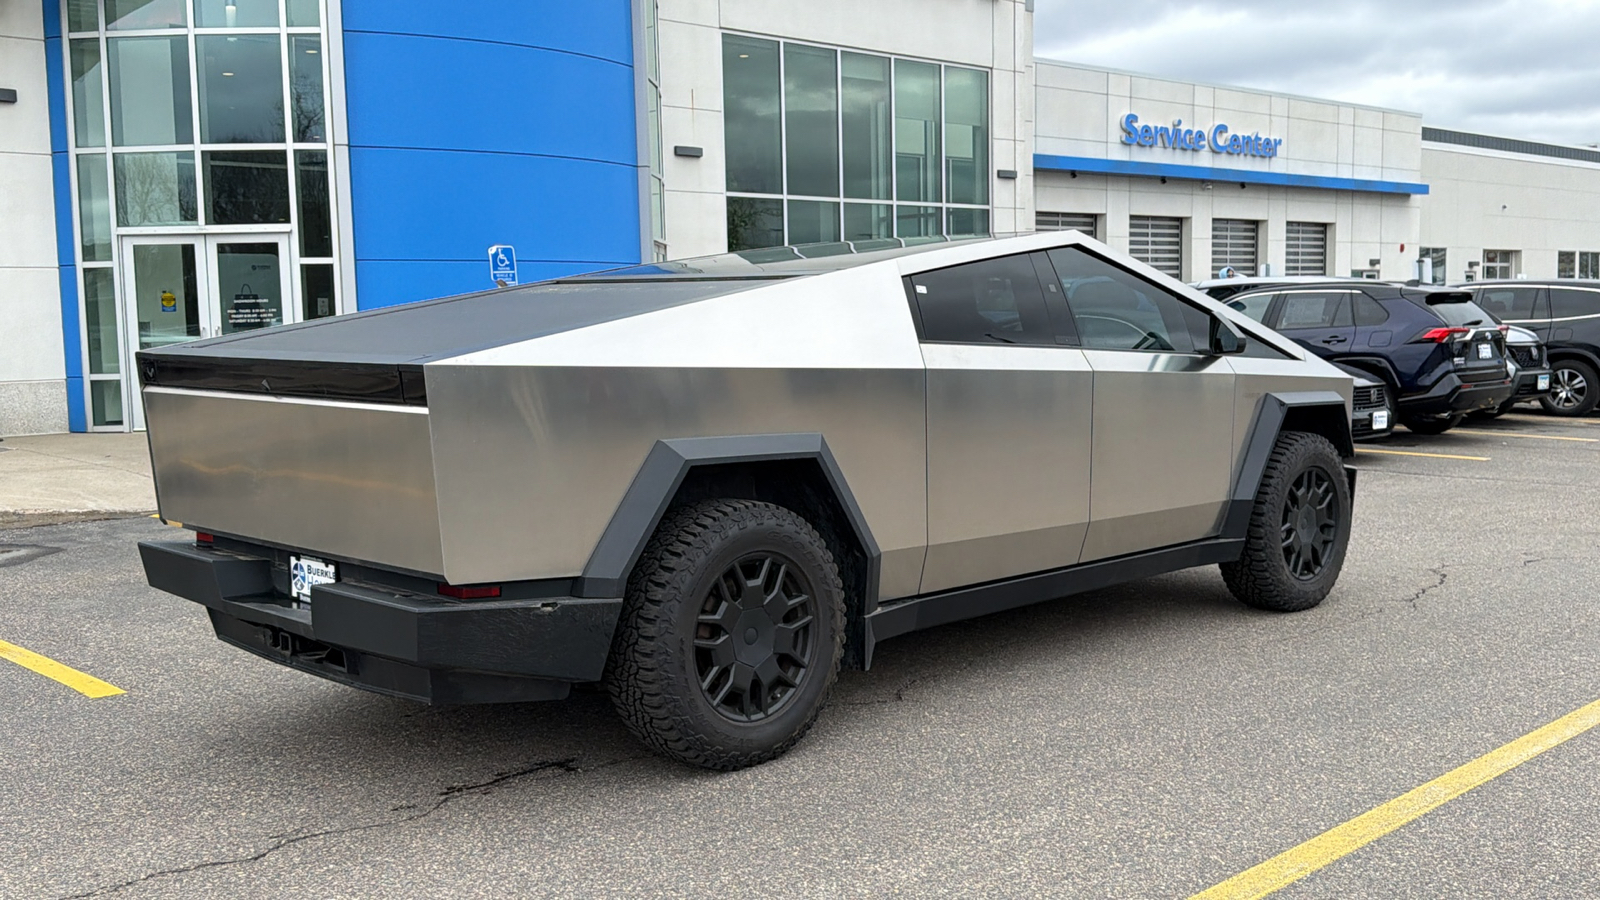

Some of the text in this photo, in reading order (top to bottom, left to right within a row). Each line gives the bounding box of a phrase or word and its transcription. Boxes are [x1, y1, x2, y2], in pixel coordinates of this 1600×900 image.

[1120, 113, 1282, 157] Service Center
[306, 564, 336, 580] BUERKLE
